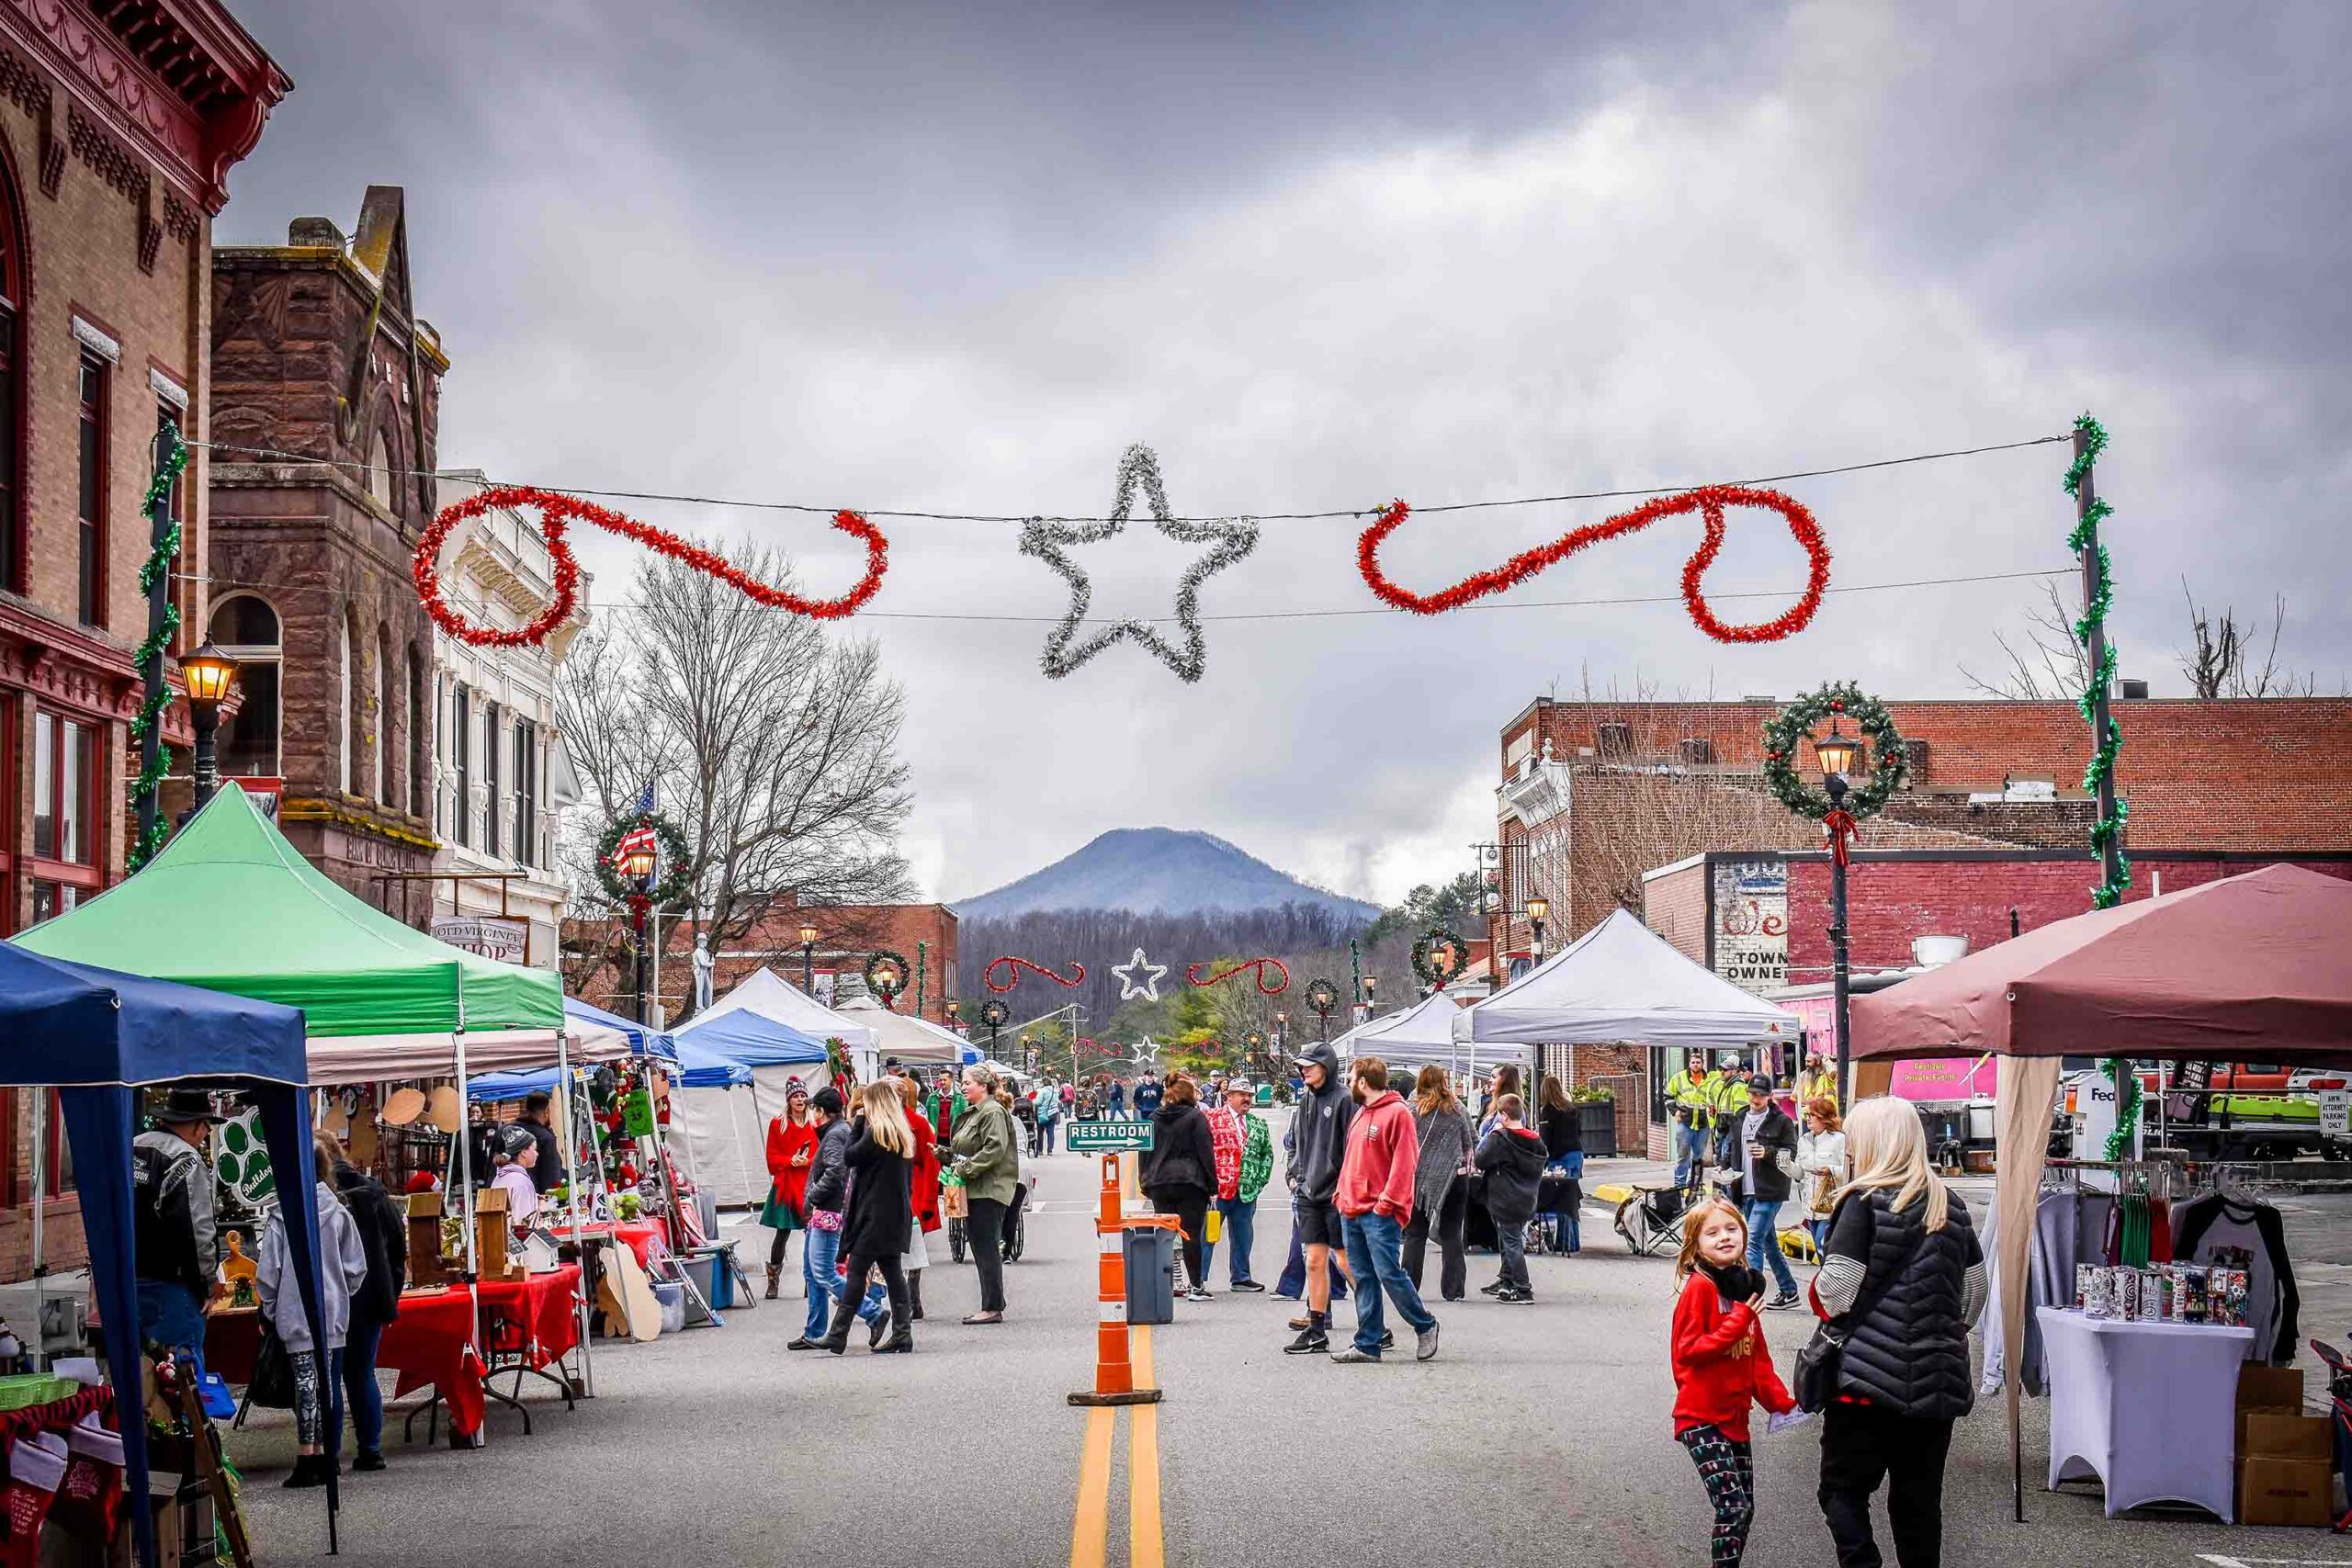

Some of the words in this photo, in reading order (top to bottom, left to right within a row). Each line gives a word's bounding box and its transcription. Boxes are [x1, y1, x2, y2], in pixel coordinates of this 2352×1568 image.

[437, 926, 462, 936] OLD
[464, 926, 517, 942] VIRGINIA
[1736, 953, 1788, 964] TOWN
[2091, 1088, 2116, 1101] Fed
[1071, 1125, 1150, 1137] RESTROOM
